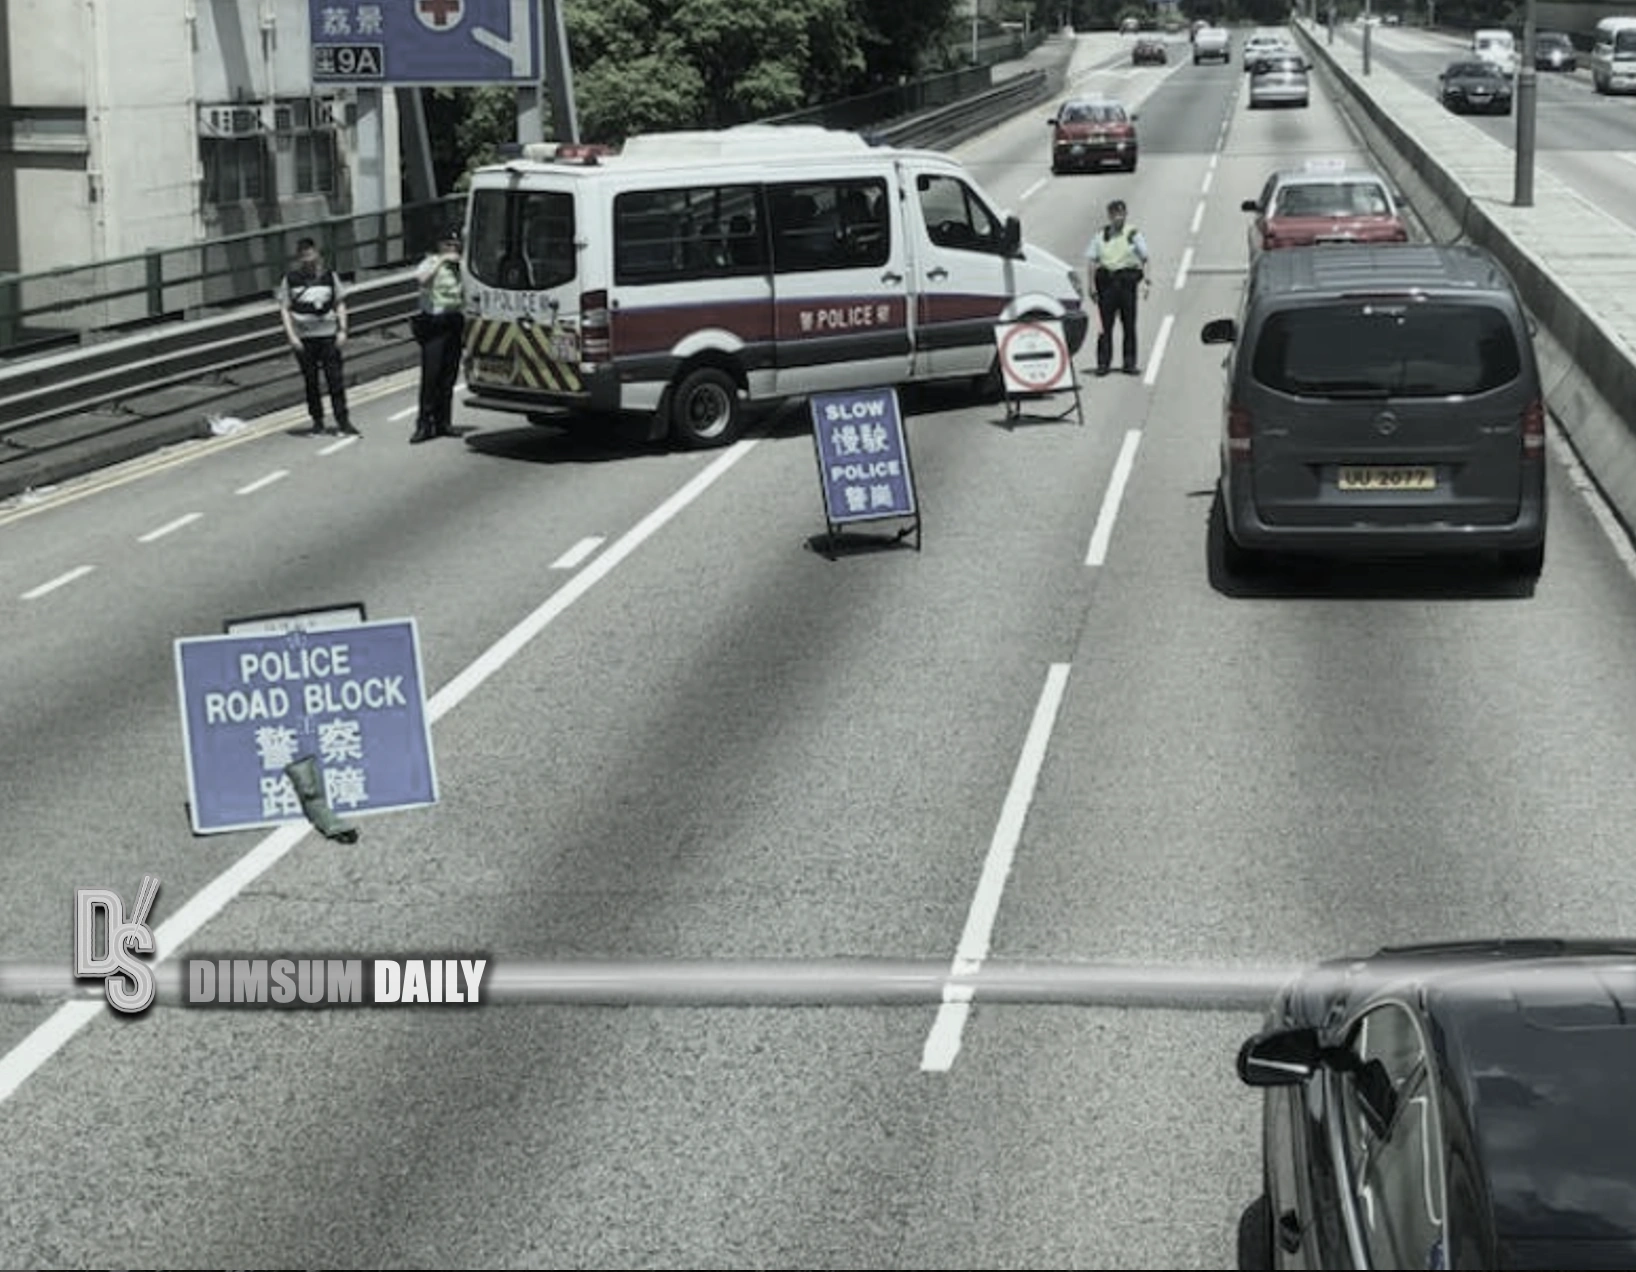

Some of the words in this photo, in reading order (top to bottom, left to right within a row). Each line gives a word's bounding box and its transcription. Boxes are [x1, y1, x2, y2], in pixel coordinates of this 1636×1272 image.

[321, 6, 383, 35] 荔景
[337, 50, 378, 73] 9A
[816, 306, 874, 329] POLICE
[825, 401, 884, 420] SLOW
[831, 422, 889, 456] 慢駛
[831, 460, 900, 482] POLICE
[240, 645, 352, 684] POLICE
[205, 687, 290, 724] ROAD
[303, 675, 407, 714] BLOCK
[254, 717, 363, 771] 警察
